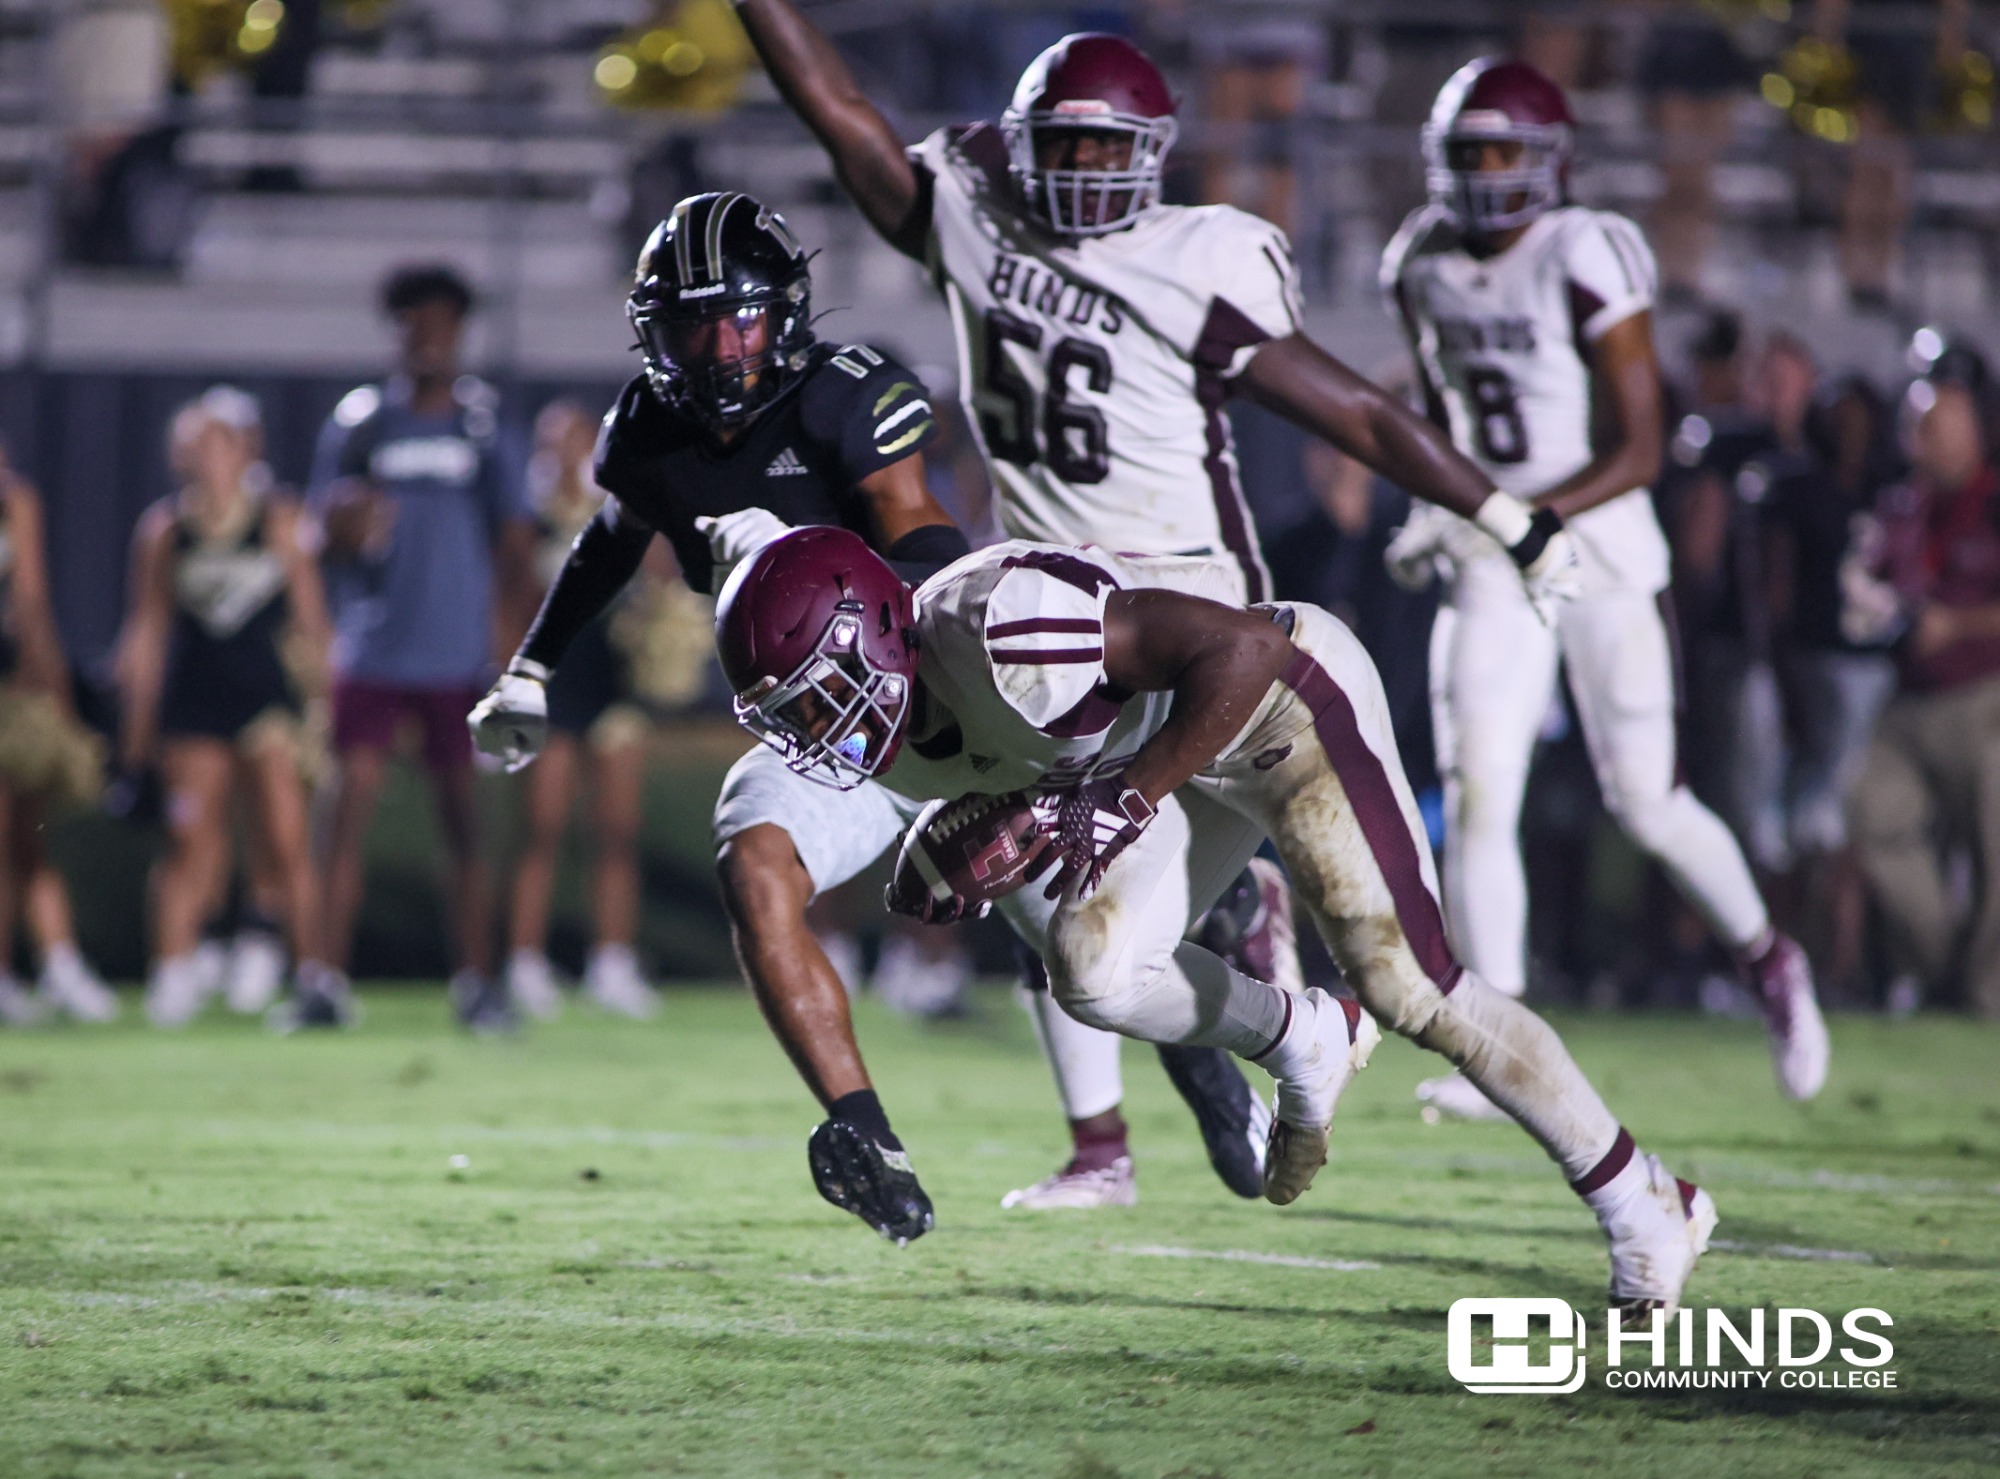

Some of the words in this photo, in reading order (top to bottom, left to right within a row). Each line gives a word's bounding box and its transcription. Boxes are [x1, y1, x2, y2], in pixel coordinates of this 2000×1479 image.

[989, 254, 1124, 335] HINDS
[982, 307, 1113, 484] 56
[1465, 366, 1530, 464] 8
